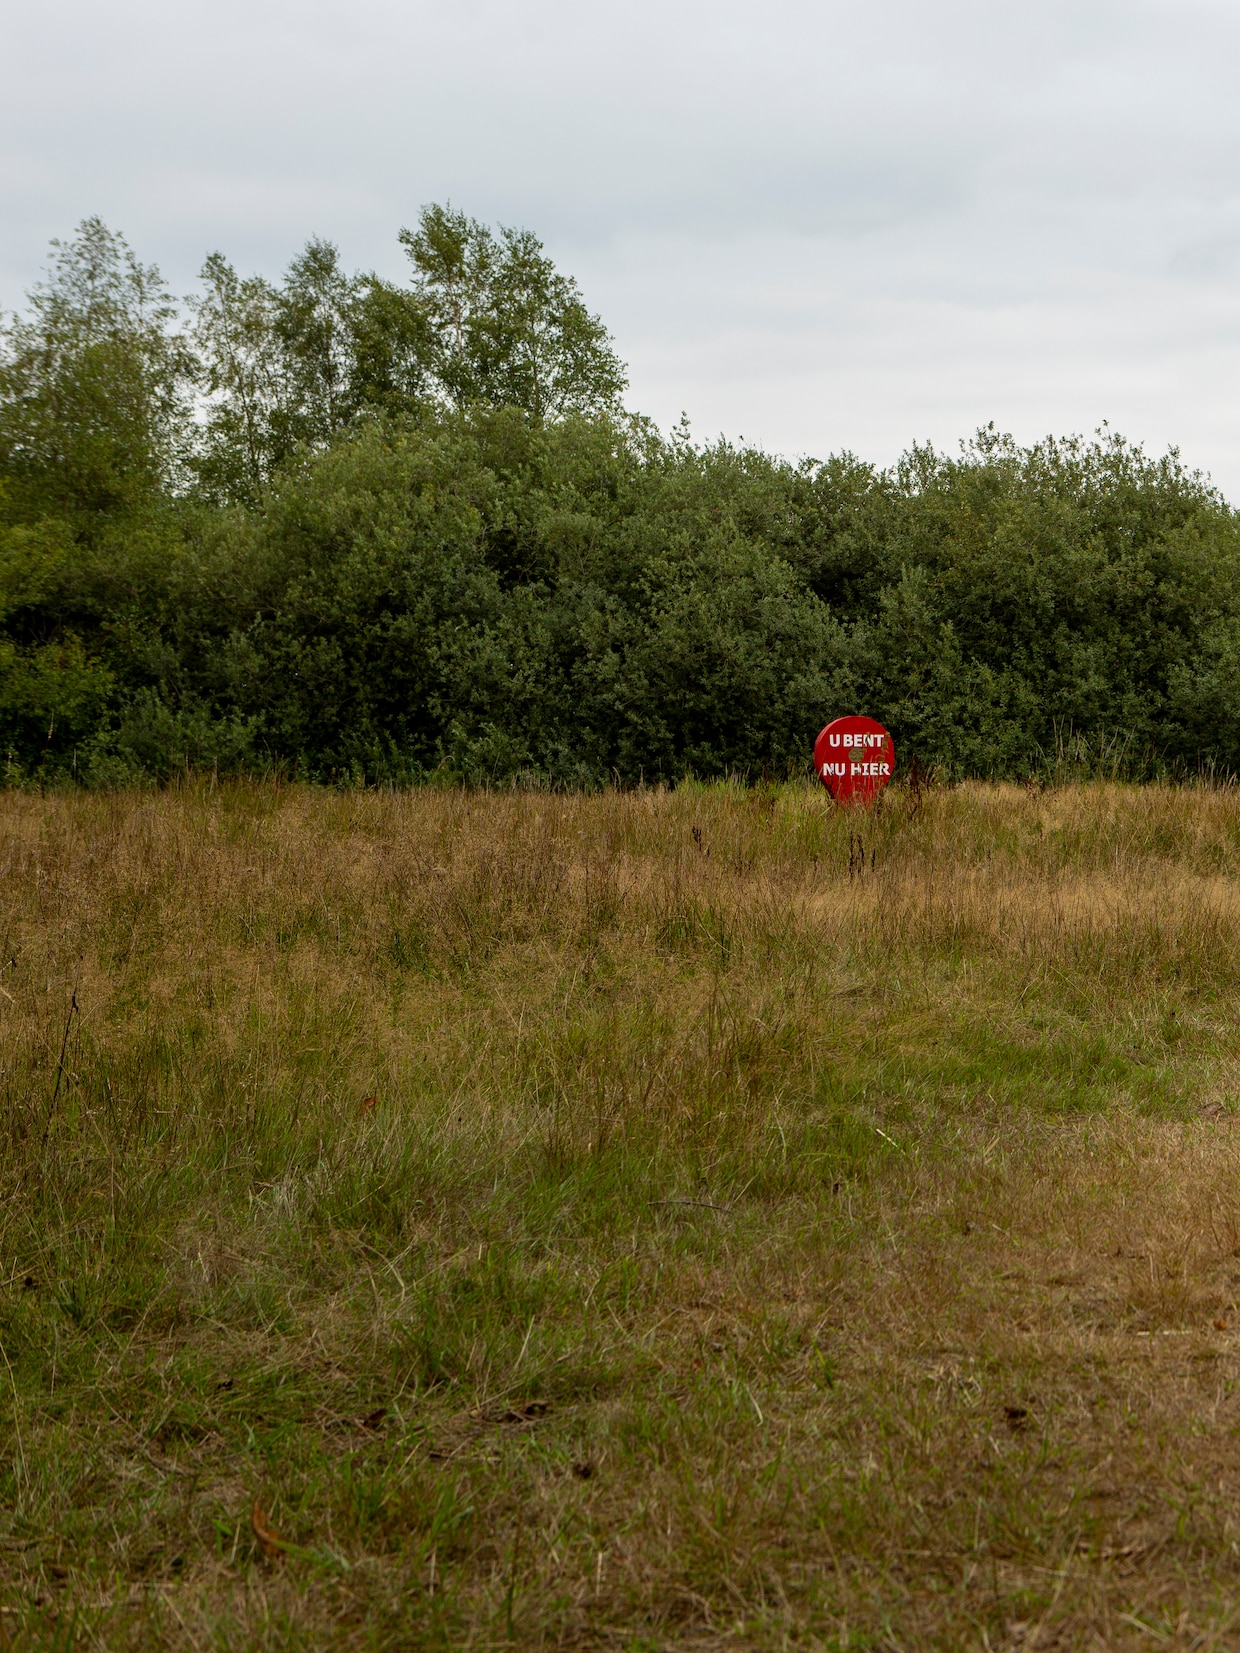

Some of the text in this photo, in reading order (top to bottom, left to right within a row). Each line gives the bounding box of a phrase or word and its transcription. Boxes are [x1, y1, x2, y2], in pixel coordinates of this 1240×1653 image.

[829, 734, 884, 747] U BENT
[823, 763, 891, 776] NU HIER
